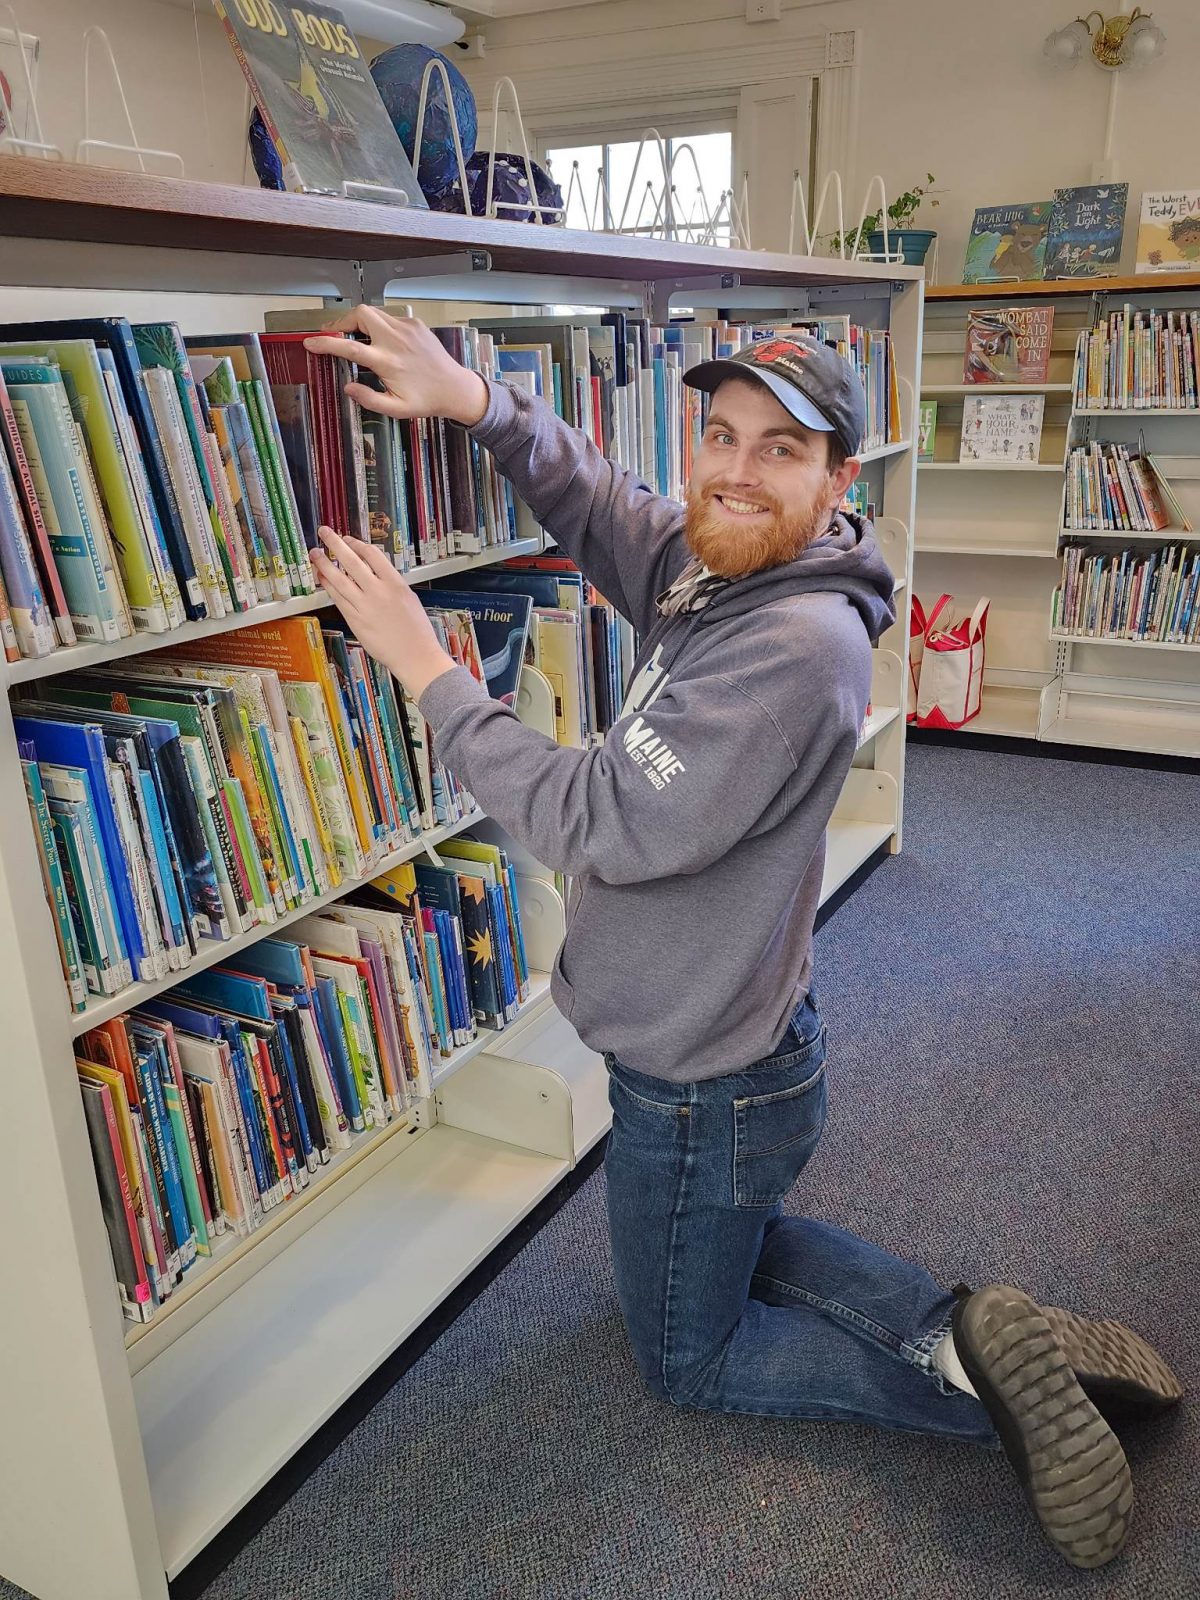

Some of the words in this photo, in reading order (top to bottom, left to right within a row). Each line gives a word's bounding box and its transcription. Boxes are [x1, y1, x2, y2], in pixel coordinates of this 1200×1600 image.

[292, 8, 359, 59] BODS
[1076, 202, 1101, 213] Dark
[1148, 196, 1160, 204] The
[1162, 194, 1188, 204] Worst
[977, 213, 1001, 224] BEAR
[1005, 211, 1024, 222] HUG
[1074, 215, 1101, 229] Light
[1148, 205, 1177, 219] Teddy
[999, 311, 1049, 324] WOMBAT
[1019, 324, 1048, 336] SAID
[1015, 337, 1047, 349] COME
[775, 356, 804, 375] Maine
[1027, 350, 1041, 362] IN
[5, 369, 43, 380] UIDES
[61, 402, 80, 457] FOSSILS
[986, 421, 1016, 430] YOUR
[4, 407, 27, 469] PREHISTORIC
[22, 472, 37, 506] ACTUAL
[32, 509, 43, 529] SIZE
[152, 438, 170, 485] DINOSAUR
[163, 483, 177, 515] BONES
[177, 442, 193, 491] DINOSAUR
[190, 493, 209, 555] DISCOVERIES
[71, 476, 87, 520] SECRETS
[91, 554, 104, 585] ROCKS
[483, 607, 514, 623] Floor
[212, 709, 230, 760] EYEWITNESS
[335, 722, 347, 752] animal
[343, 754, 353, 776] atlas
[623, 716, 686, 784] MAINE
[630, 750, 647, 767] EST.
[644, 765, 666, 791] 1820
[305, 760, 321, 806] CARNIVOROUS
[318, 807, 328, 831] PLANTS
[37, 802, 46, 816] The
[40, 820, 51, 846] Secret
[46, 847, 56, 865] Pool
[209, 803, 221, 832] Microbes
[218, 833, 226, 848] That
[222, 850, 231, 868] Shape
[232, 883, 240, 899] Lives
[214, 800, 233, 856] INVISIBLE
[231, 861, 244, 897] ALLIES
[143, 1072, 151, 1092] KIDS
[147, 1092, 154, 1103] IN
[149, 1103, 157, 1119] THE
[133, 1064, 143, 1087] FROST
[145, 1123, 157, 1154] UNDER
[152, 1158, 164, 1192] THREAT
[153, 1119, 162, 1139] WILD
[179, 1088, 195, 1138] AUSTRALIAN
[190, 1140, 202, 1174] ANIMALS
[157, 1139, 169, 1172] GARDEN
[120, 1171, 133, 1209] VENOM
